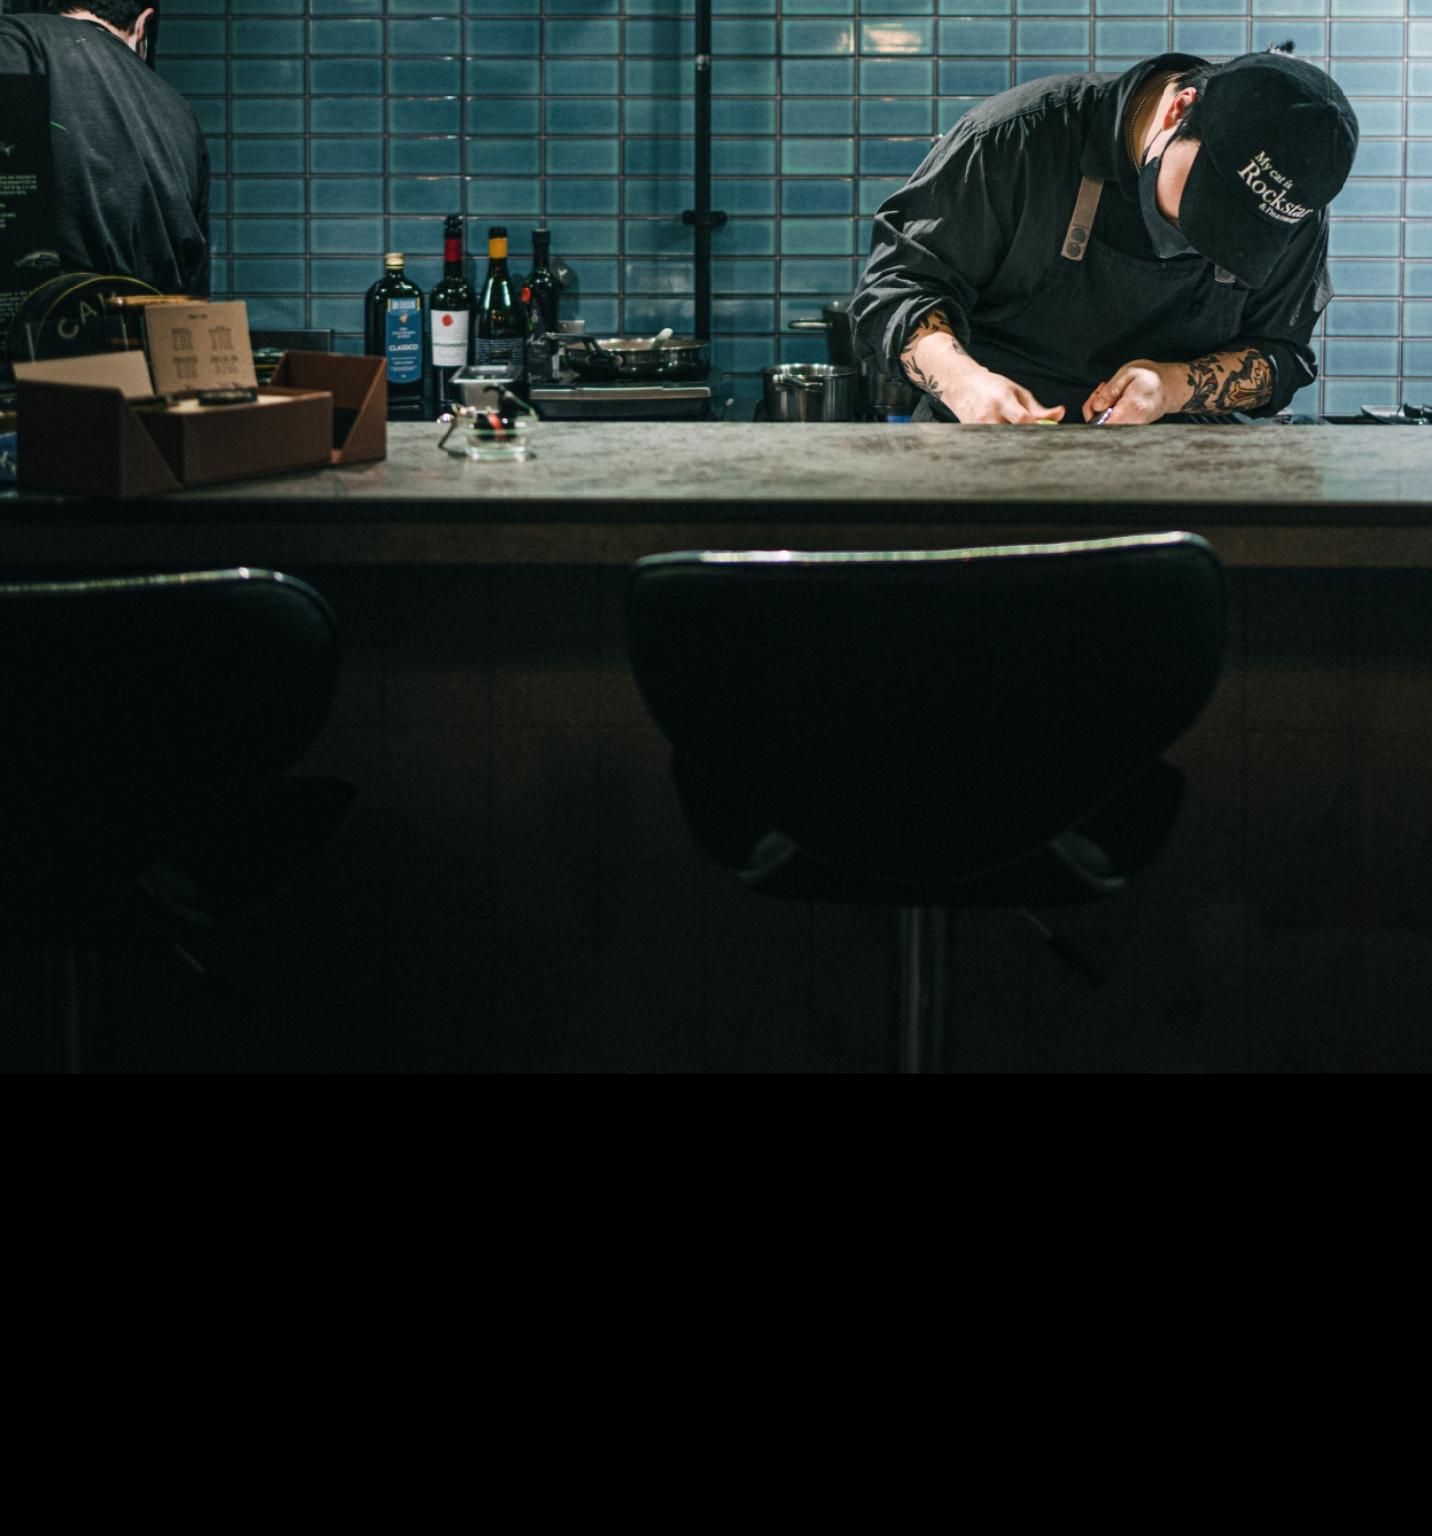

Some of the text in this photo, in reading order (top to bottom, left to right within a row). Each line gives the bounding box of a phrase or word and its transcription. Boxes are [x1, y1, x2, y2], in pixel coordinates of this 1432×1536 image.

[1236, 159, 1314, 218] Rockstar
[1254, 150, 1273, 172] My
[1269, 170, 1287, 184] cat
